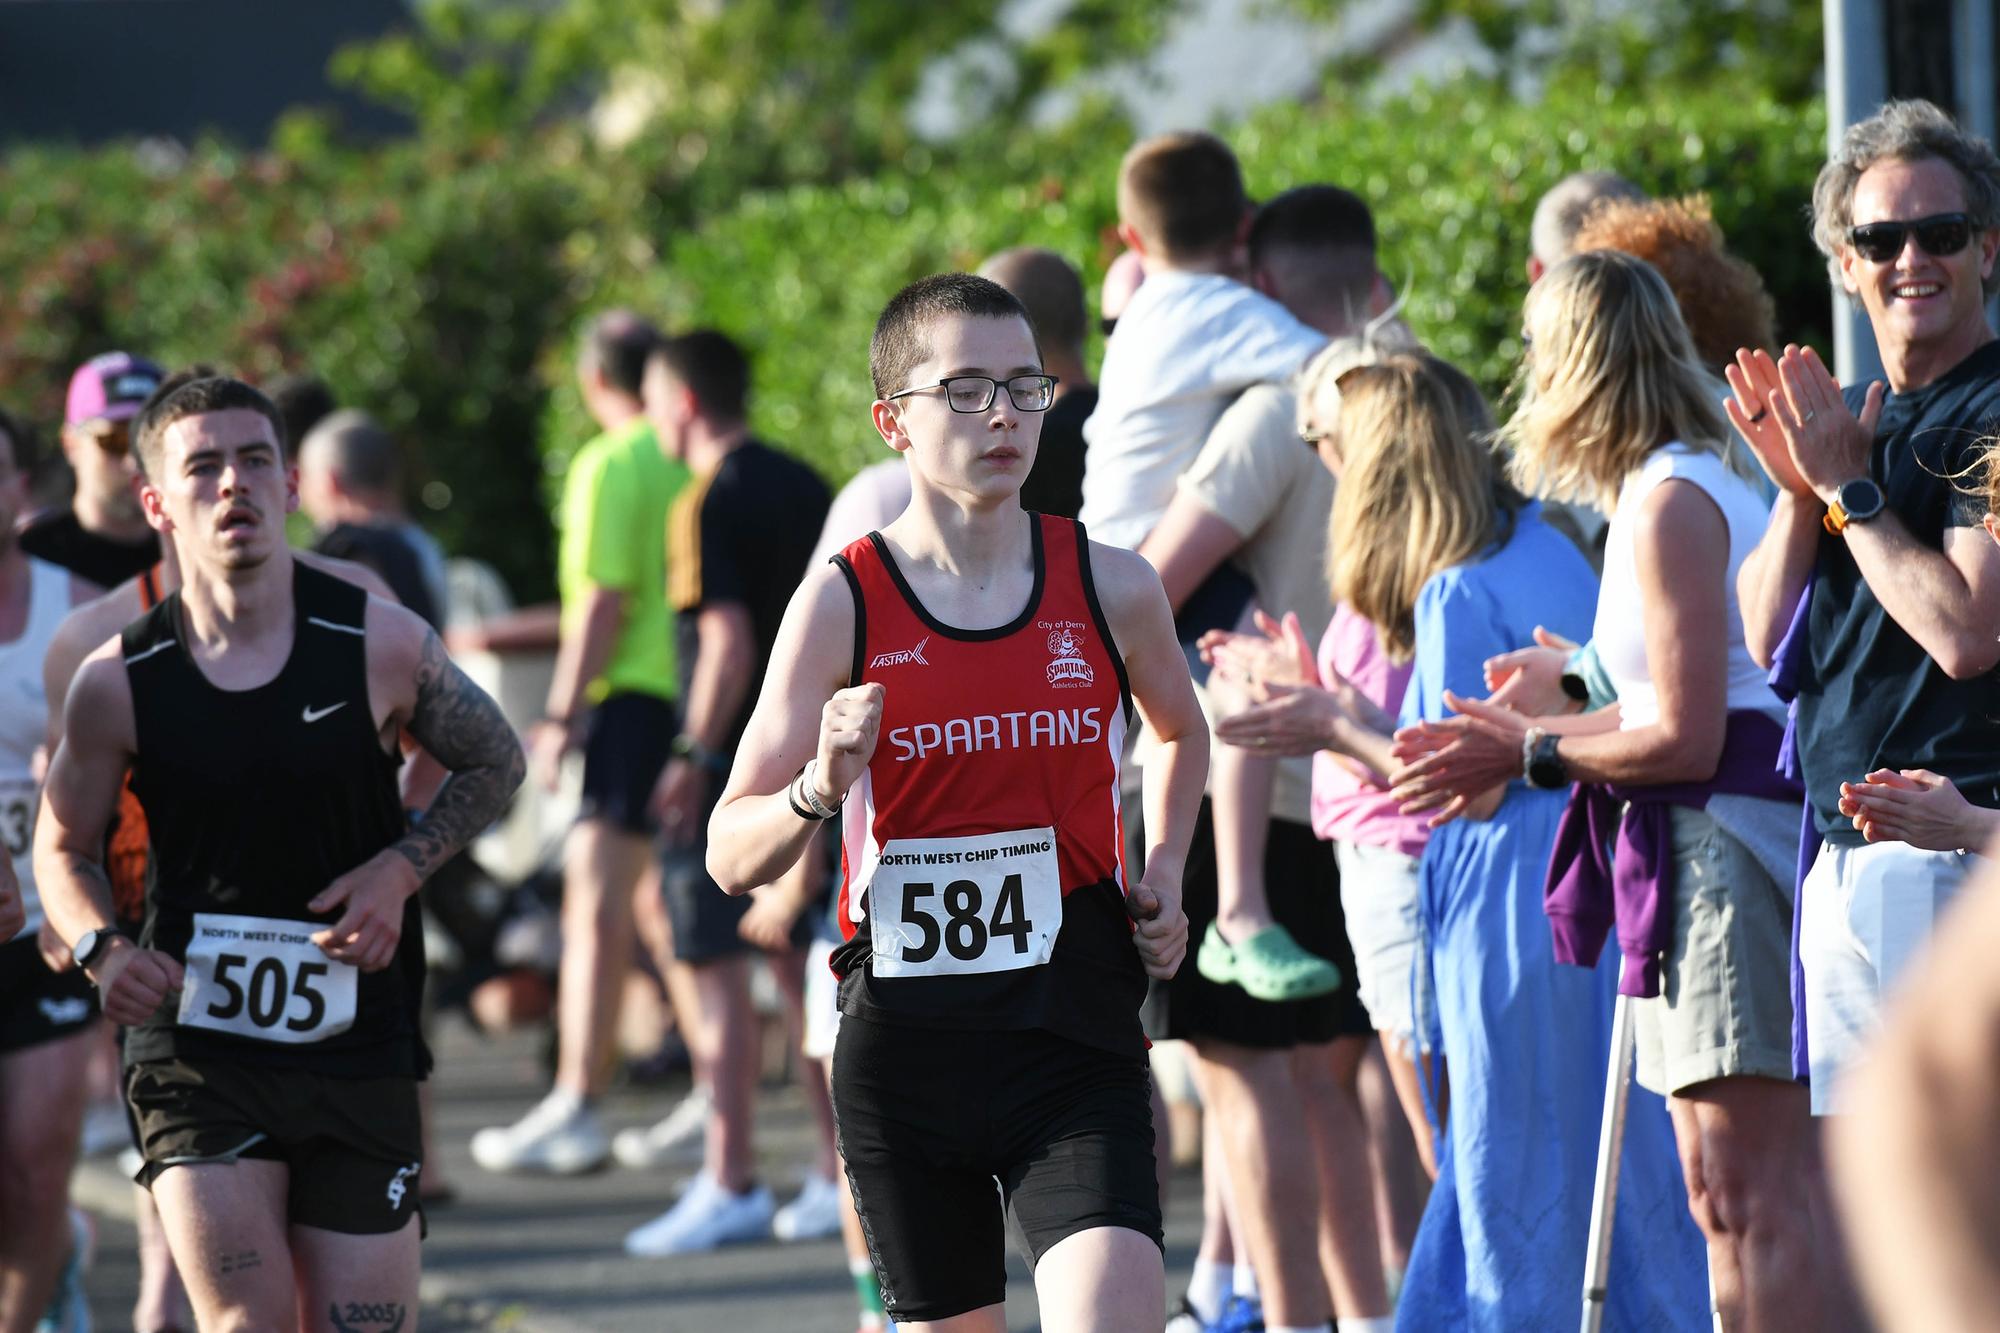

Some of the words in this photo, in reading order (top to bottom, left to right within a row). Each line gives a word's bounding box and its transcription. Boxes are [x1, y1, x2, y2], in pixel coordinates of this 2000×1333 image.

[1037, 620, 1052, 630] City
[1055, 620, 1063, 628] of
[1065, 620, 1086, 630] Derry
[1047, 662, 1093, 682] SPARTANS
[1052, 681, 1077, 689] Athletics
[889, 707, 1101, 762] SPARTANS
[923, 852, 962, 865] WEST
[964, 849, 998, 863] CHIP
[1001, 842, 1051, 858] TIMING
[901, 873, 1033, 964] 584
[202, 927, 241, 940] NORTH
[243, 929, 277, 942] WEST
[279, 933, 309, 944] CHIP
[207, 953, 328, 1031] 505
[345, 1301, 396, 1323] 2005
